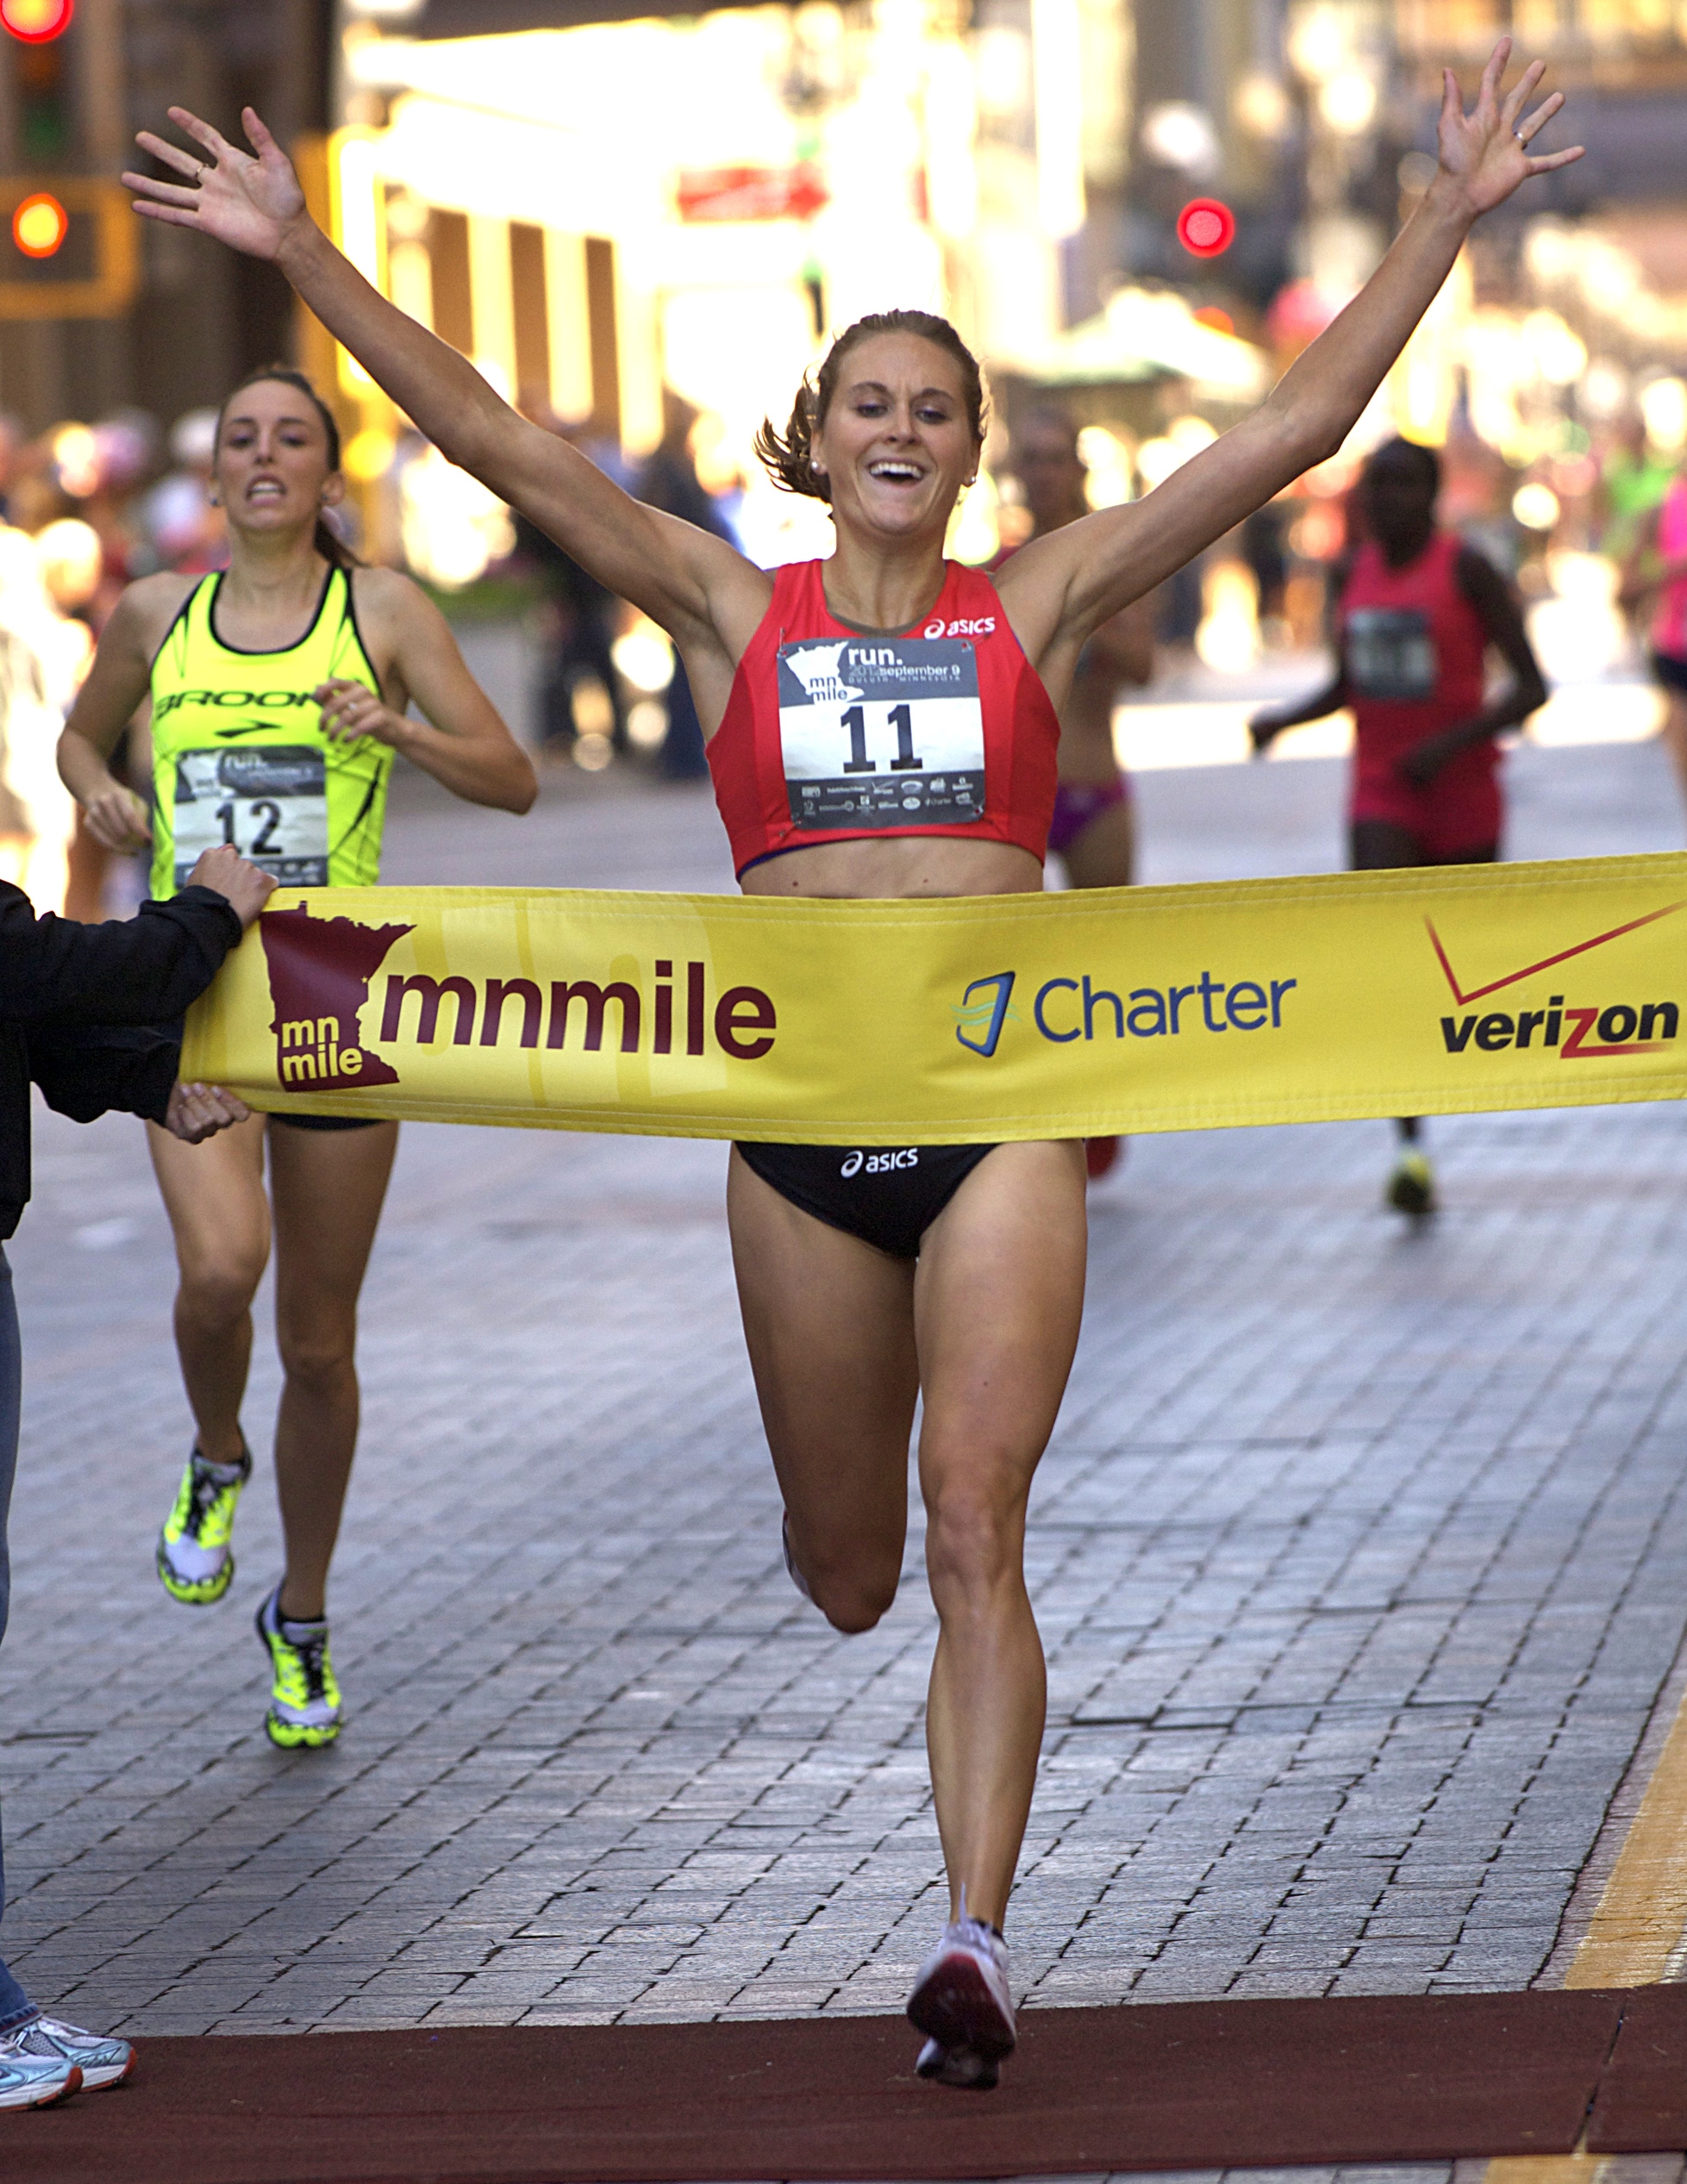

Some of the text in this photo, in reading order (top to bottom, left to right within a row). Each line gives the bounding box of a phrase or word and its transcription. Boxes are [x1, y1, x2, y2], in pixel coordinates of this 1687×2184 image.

[947, 617, 995, 636] asics
[848, 648, 903, 665] run.
[809, 675, 836, 688] mn
[811, 684, 847, 702] mile
[840, 704, 922, 774] 11
[216, 800, 282, 855] 12
[379, 960, 777, 1060] mnmile
[1034, 970, 1296, 1042] Charter
[282, 1016, 341, 1049] mn
[1440, 995, 1678, 1059] verizon
[282, 1042, 363, 1082] mile
[865, 1147, 918, 1173] asics
